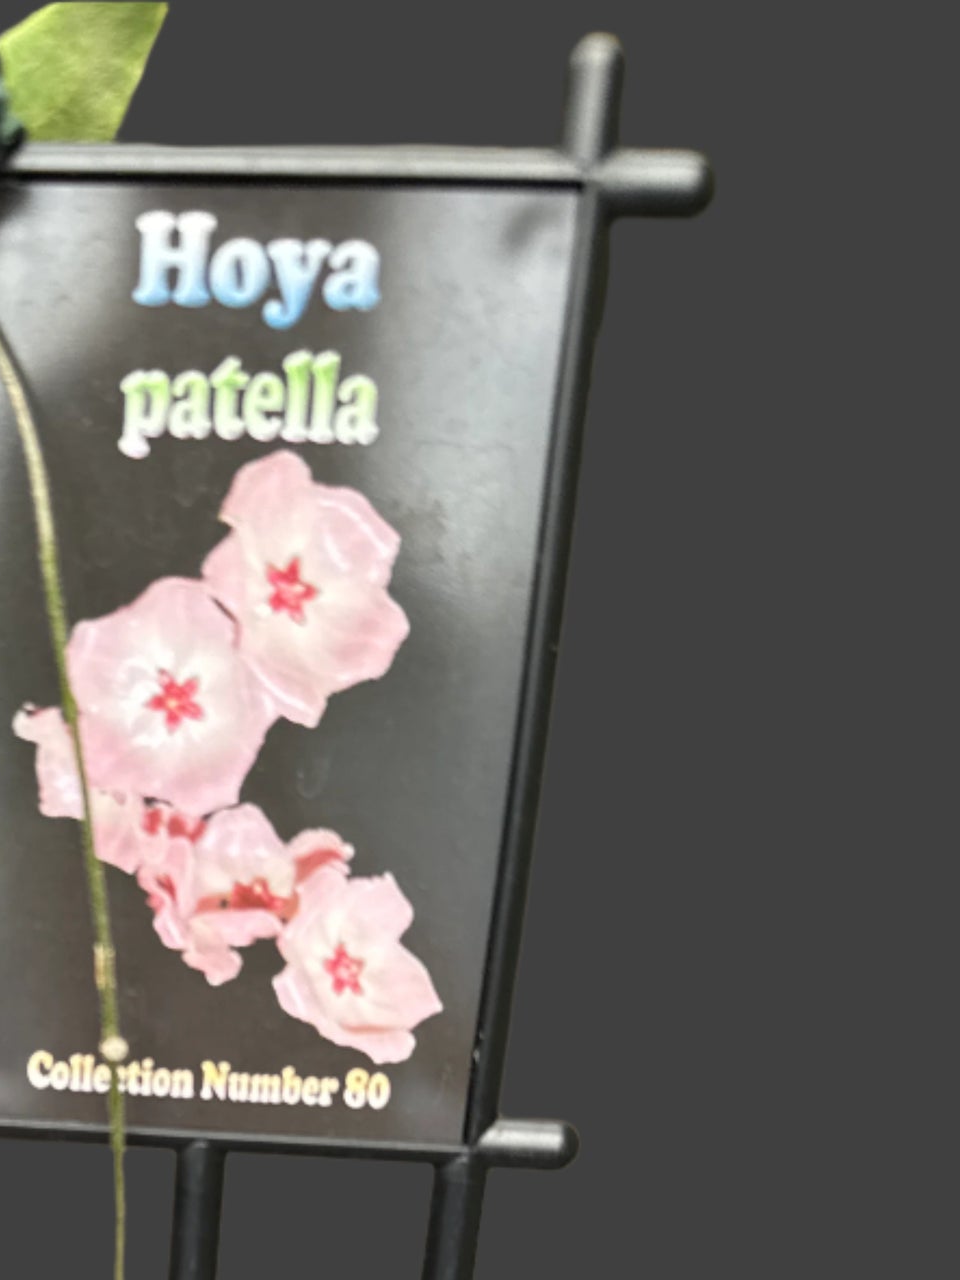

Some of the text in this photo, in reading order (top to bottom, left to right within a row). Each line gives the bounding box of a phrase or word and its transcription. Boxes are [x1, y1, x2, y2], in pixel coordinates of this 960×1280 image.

[132, 210, 381, 329] Hoya
[117, 349, 379, 459] patella
[200, 1059, 339, 1107] Number
[344, 1067, 391, 1110] 80
